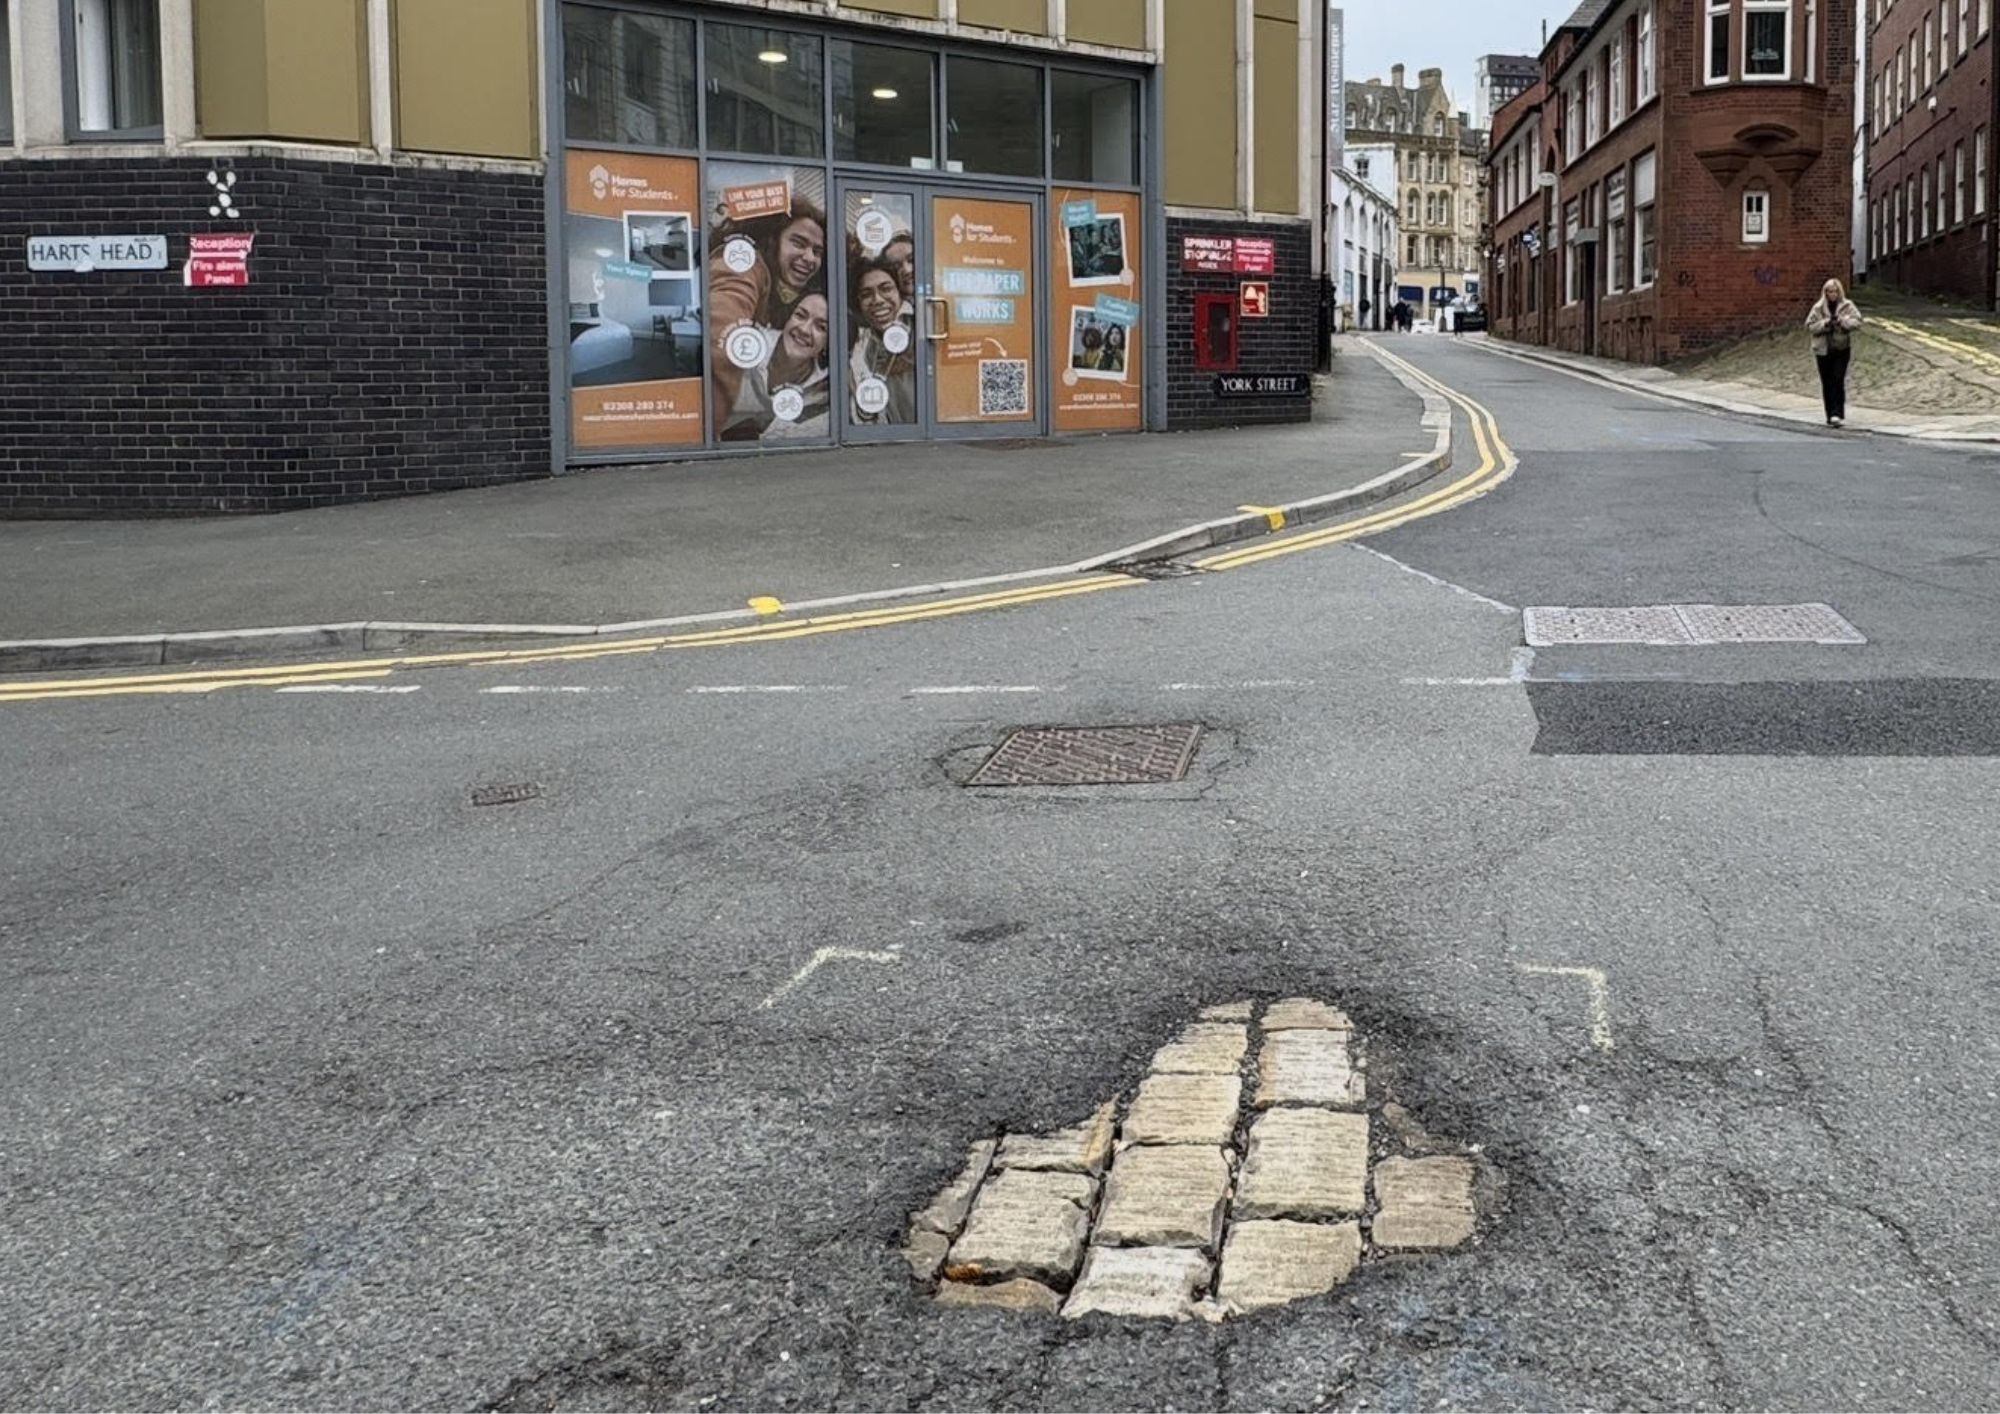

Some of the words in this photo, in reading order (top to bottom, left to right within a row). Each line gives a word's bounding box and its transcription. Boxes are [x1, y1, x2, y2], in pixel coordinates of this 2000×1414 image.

[611, 175, 648, 187] Homes
[612, 187, 626, 198] for
[628, 188, 673, 200] Students
[190, 237, 250, 251] Reception
[1184, 237, 1232, 250] SPRINKLER
[1236, 238, 1272, 249] Reception
[101, 243, 152, 260] HEAD
[193, 260, 213, 271] Fire
[216, 260, 245, 271] alarm
[204, 273, 235, 285] Panel
[961, 302, 1009, 319] WORKS
[1221, 378, 1252, 391] YORK
[1256, 377, 1297, 391] STREET
